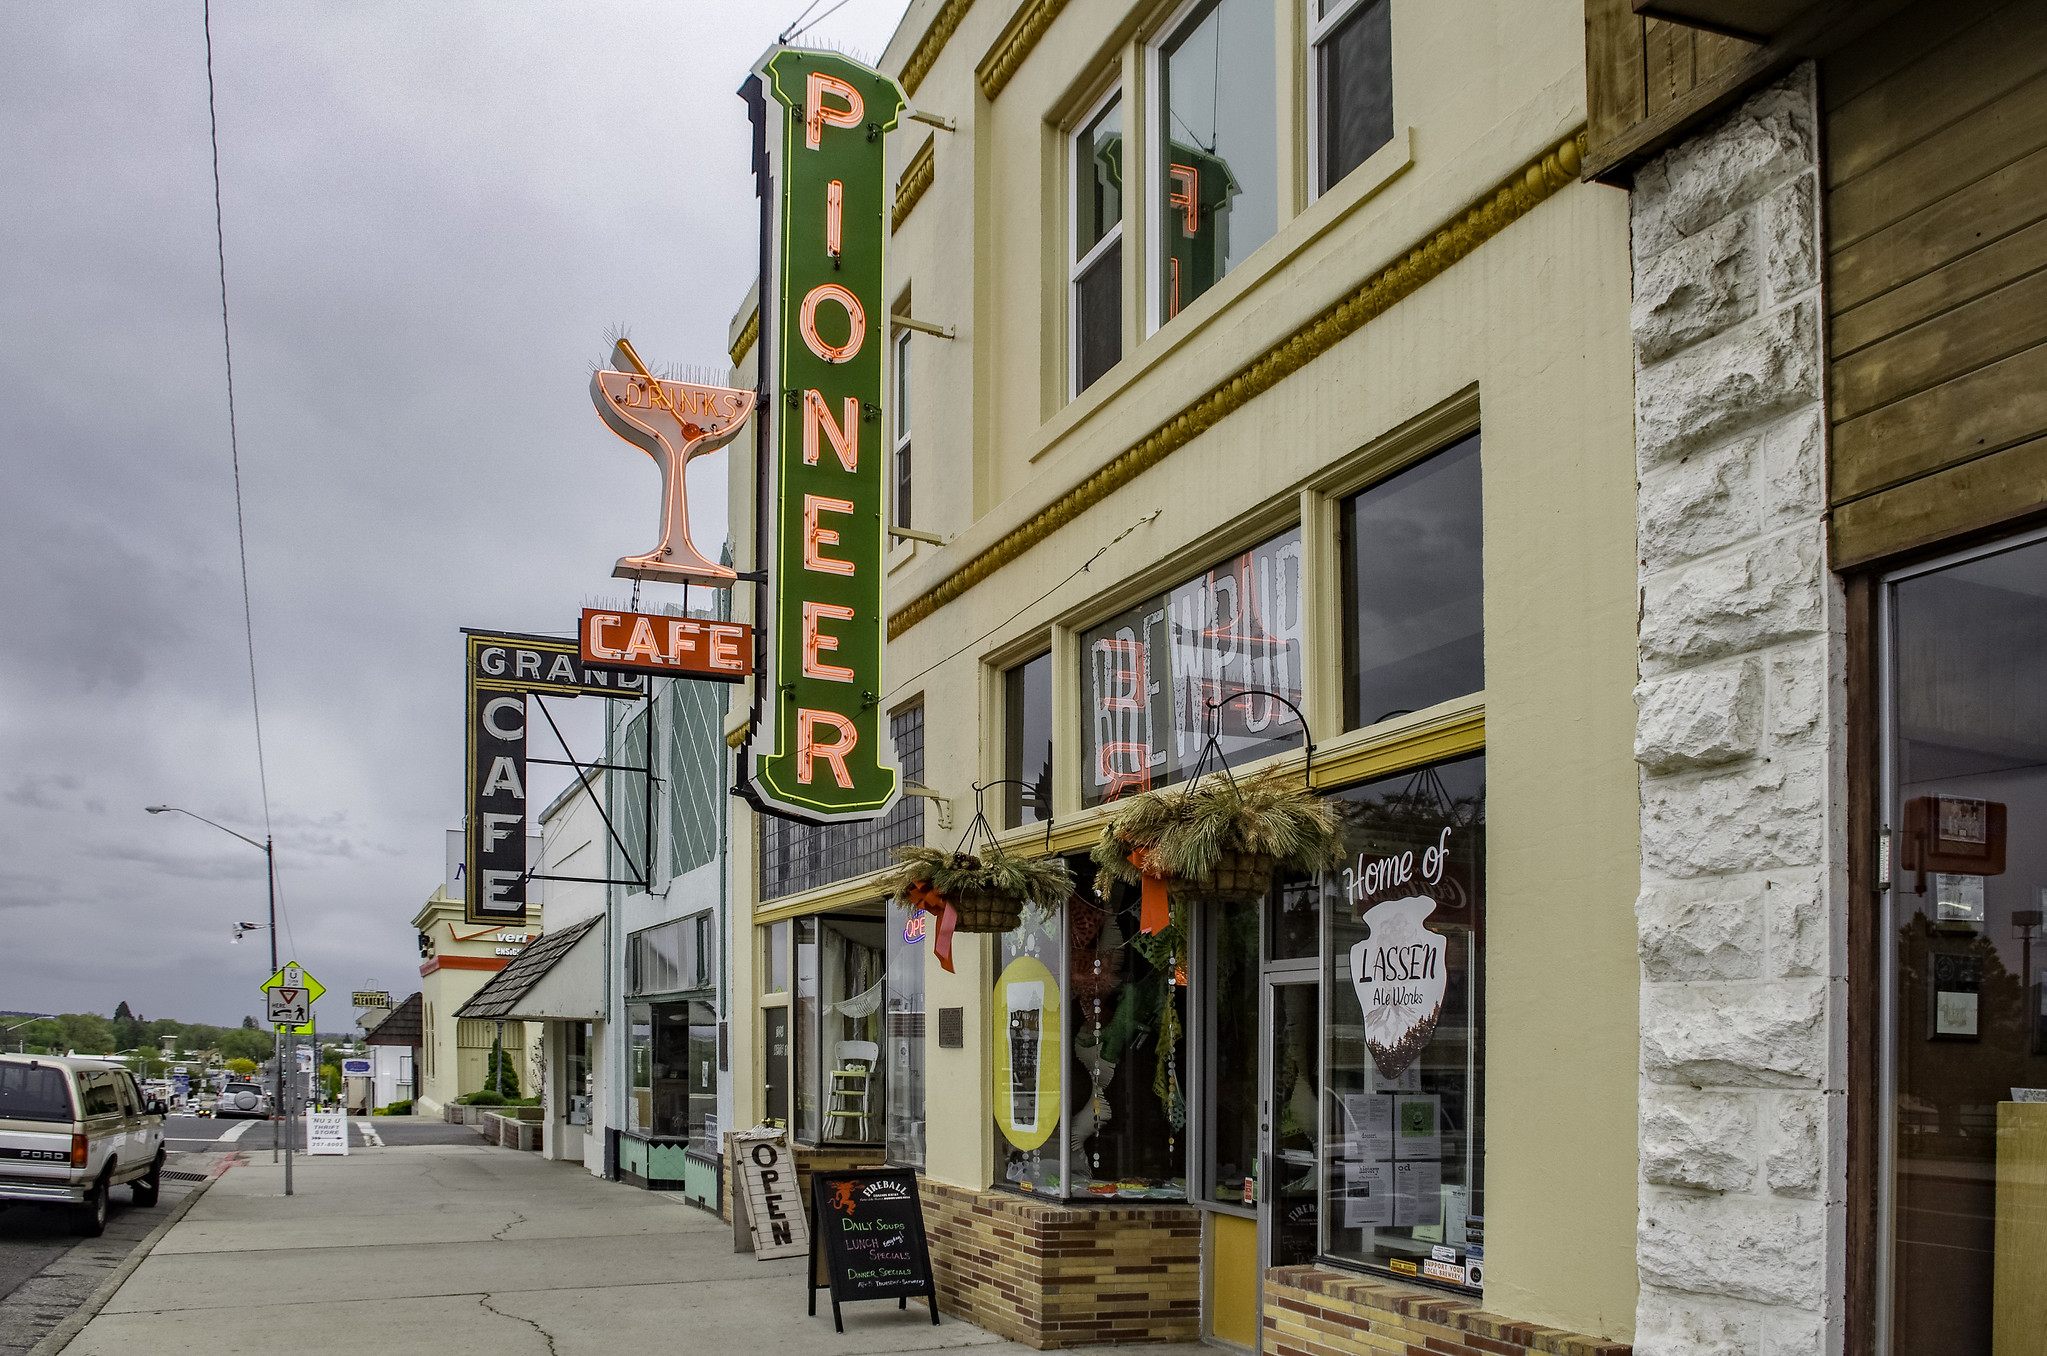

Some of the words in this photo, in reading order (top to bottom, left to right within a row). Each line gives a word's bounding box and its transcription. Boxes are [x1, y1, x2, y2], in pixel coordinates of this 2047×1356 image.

[625, 383, 737, 418] DRINKS
[796, 71, 867, 790] PIONEER
[590, 614, 744, 671] CAFE
[482, 695, 525, 912] CAFE
[1342, 850, 1414, 906] Home
[1422, 826, 1452, 886] of
[906, 916, 926, 938] OPE
[1359, 943, 1437, 983] LASSEN
[1373, 987, 1391, 1006] Ale
[1392, 986, 1424, 1006] Works
[20, 1150, 64, 1160] FORD
[752, 1143, 793, 1246] OPEN
[862, 1180, 907, 1197] FIREBALL
[845, 1238, 879, 1251] LUNCH
[1424, 1260, 1448, 1271] SUPPORT
[1449, 1265, 1464, 1274] YOUR
[1424, 1266, 1438, 1276] LOCAL
[1439, 1269, 1461, 1280] BREWERY
